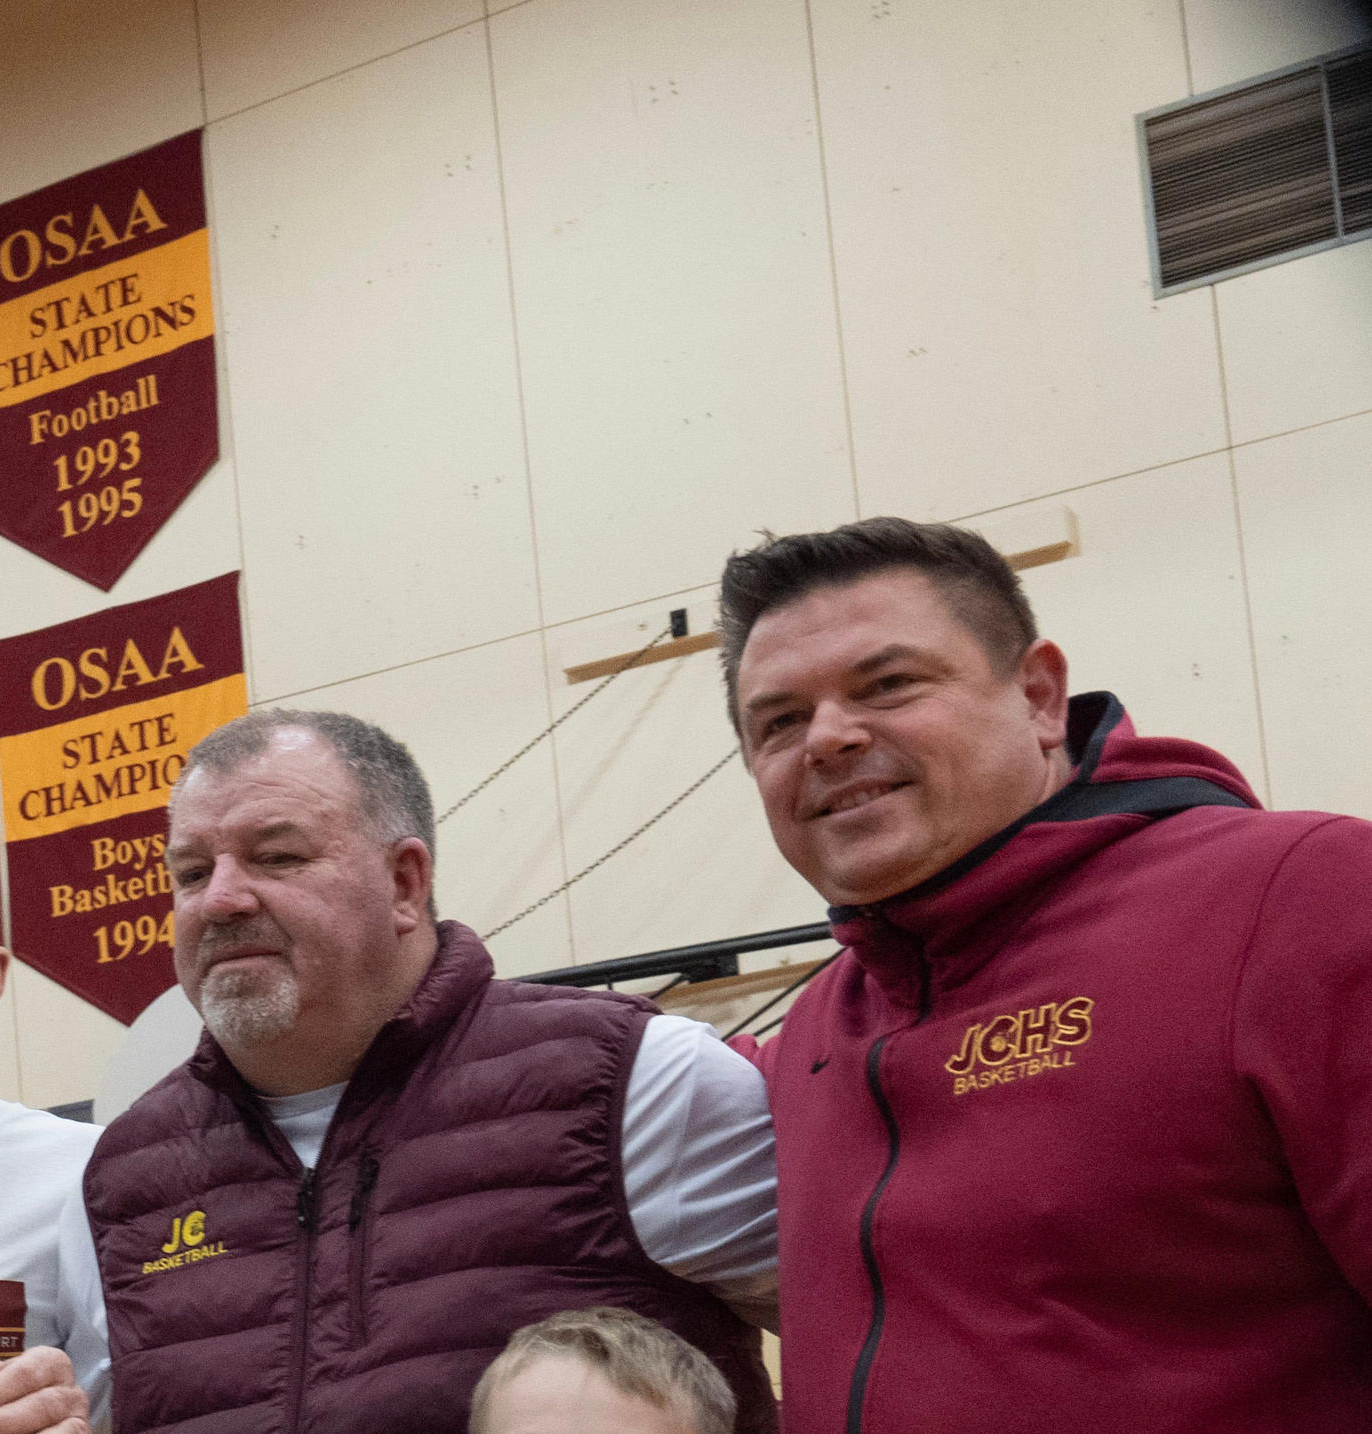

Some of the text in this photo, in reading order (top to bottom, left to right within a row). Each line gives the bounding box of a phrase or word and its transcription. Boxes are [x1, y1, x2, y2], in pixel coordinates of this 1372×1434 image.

[30, 274, 141, 339] STATE
[29, 374, 160, 445] Football
[53, 431, 141, 492] 1993
[57, 477, 143, 538] 1995
[31, 626, 205, 711] OSAA
[62, 713, 177, 770] STATE
[19, 754, 187, 821] CHAMPIO
[91, 833, 165, 871] Boys
[49, 862, 173, 918] Basketb
[93, 911, 175, 963] 1994
[944, 996, 1095, 1074] JCHS
[953, 1051, 1076, 1095] BASKETBALL
[142, 1241, 228, 1275] BASKETBALL
[162, 1210, 206, 1254] JC
